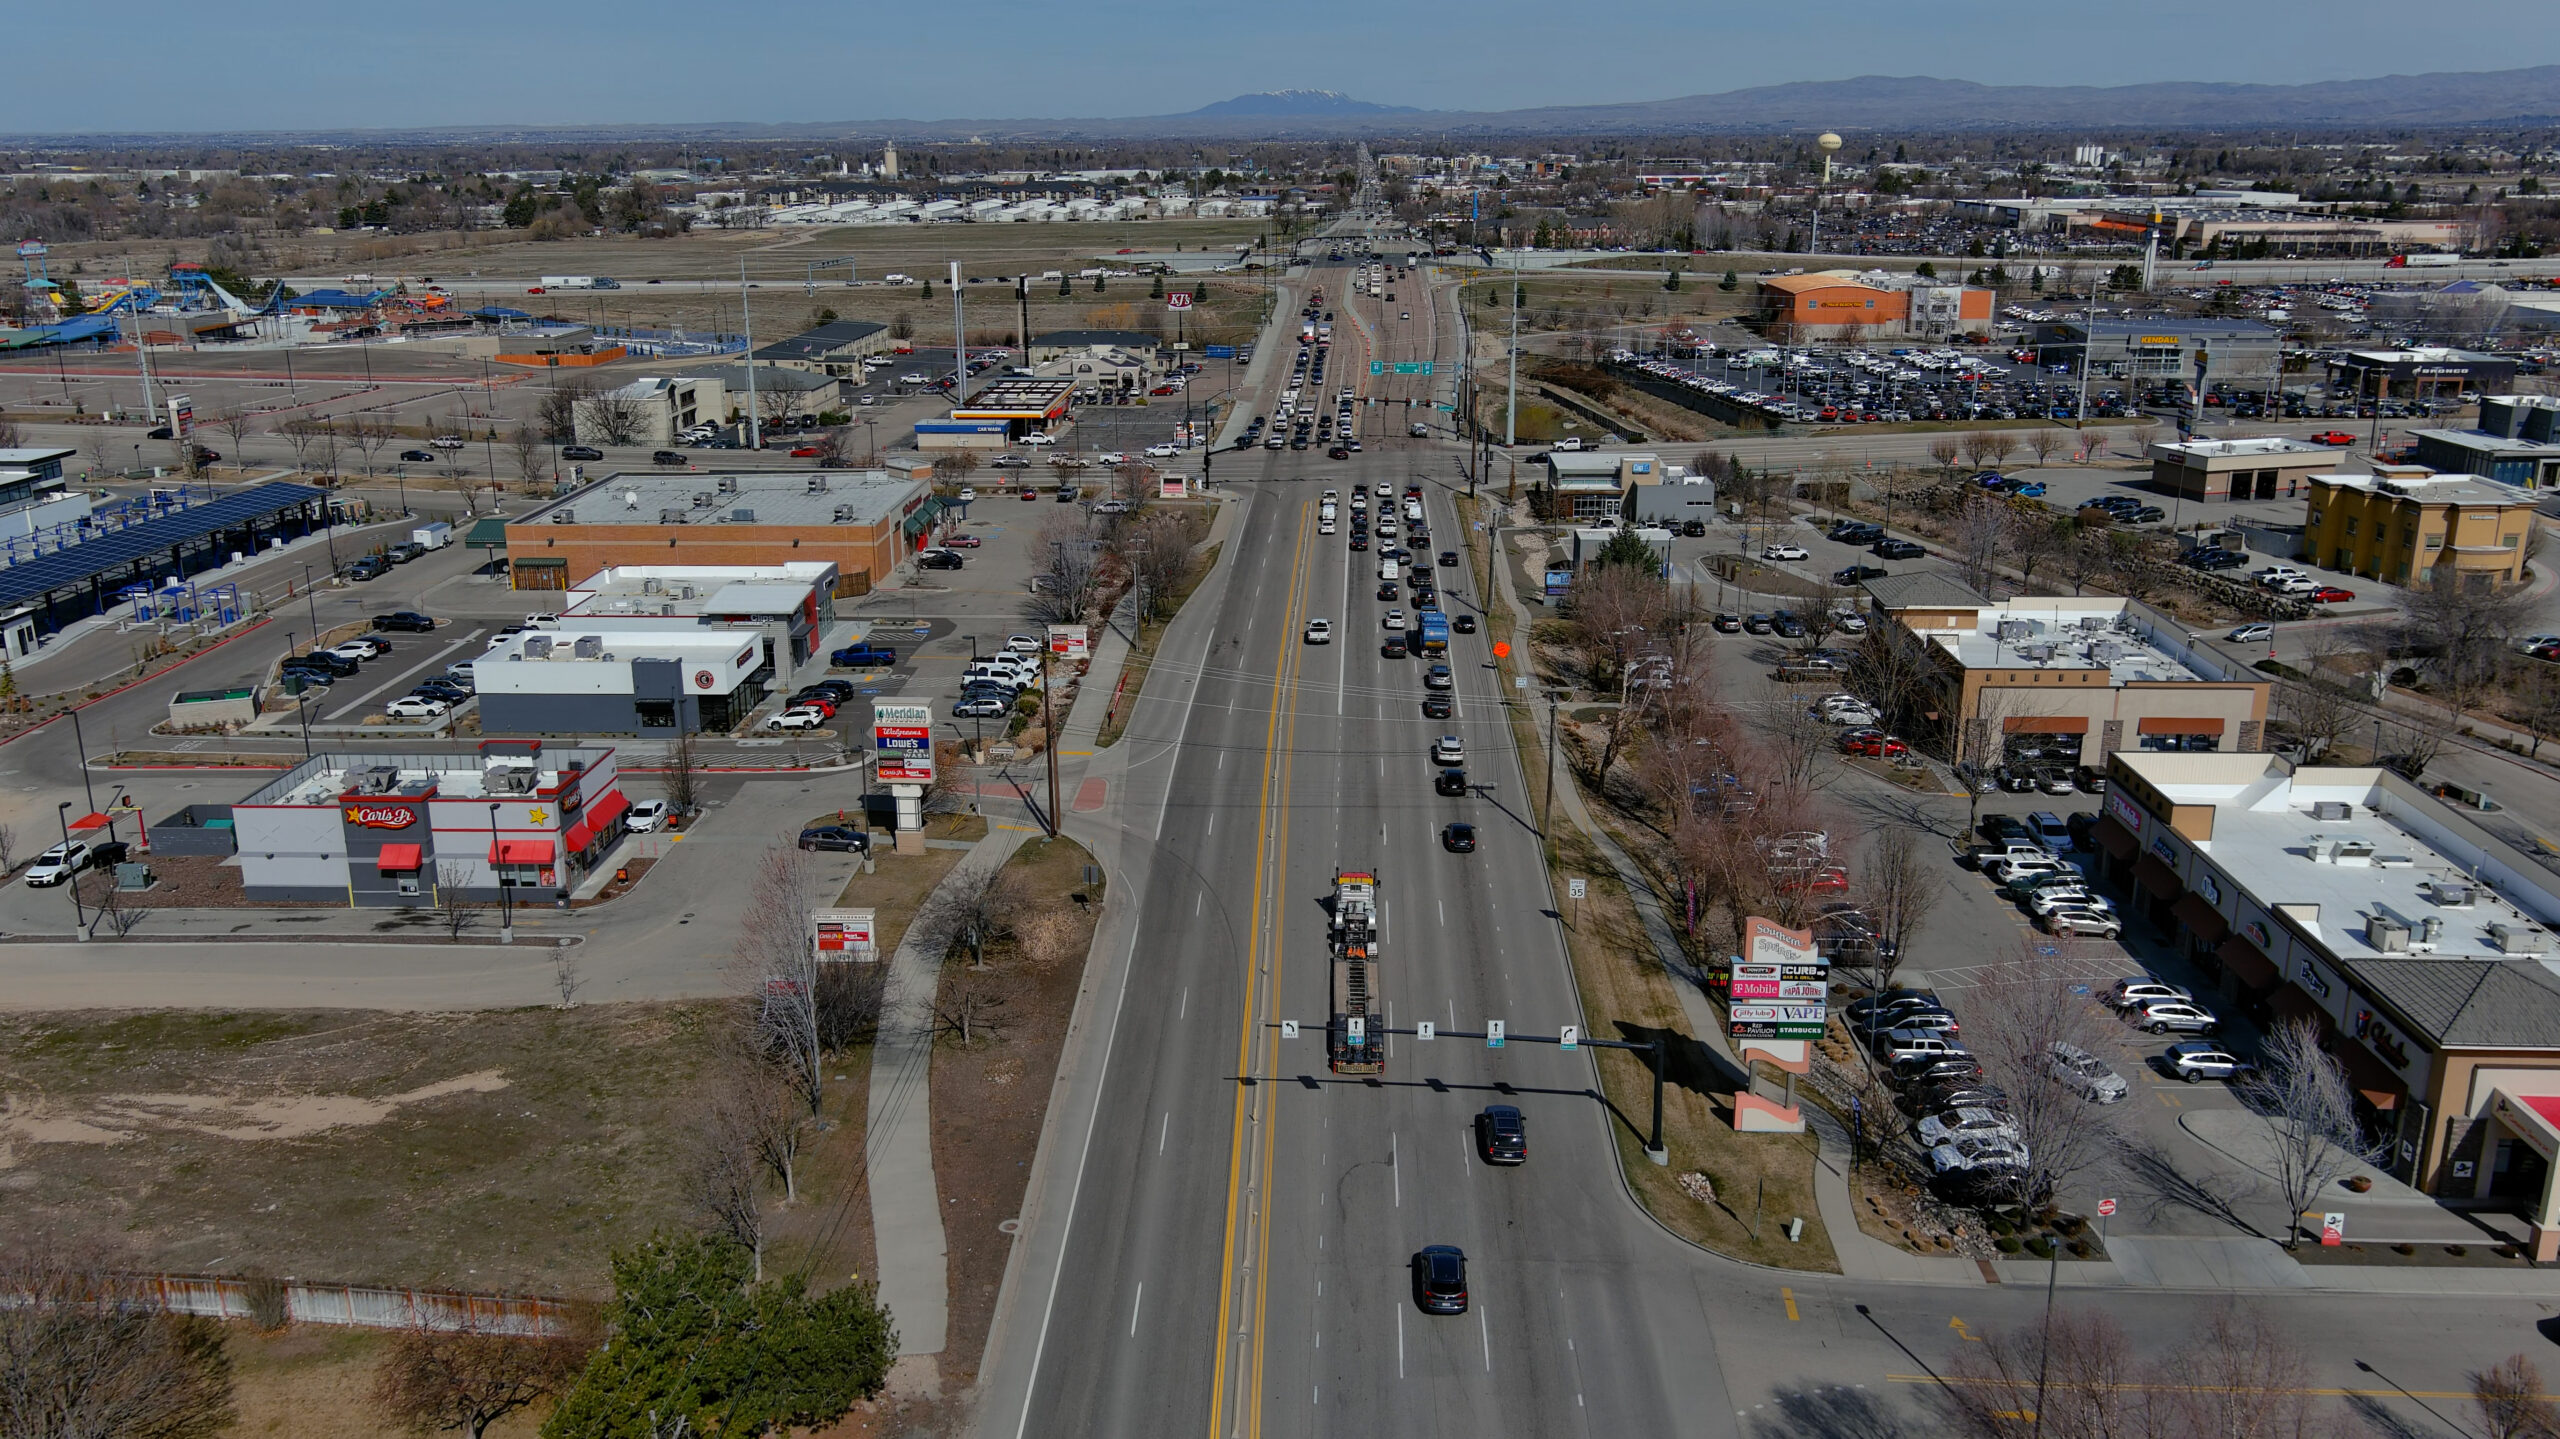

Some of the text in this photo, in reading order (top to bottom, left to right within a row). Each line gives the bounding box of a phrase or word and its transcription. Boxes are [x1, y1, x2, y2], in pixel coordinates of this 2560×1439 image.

[1170, 294, 1190, 306] KJ's
[2141, 336, 2179, 344] KENDALL
[750, 614, 775, 622] Clips
[885, 708, 926, 719] Meridian
[883, 728, 922, 737] Walgreens
[887, 738, 919, 748] LOWE'S
[360, 808, 415, 822] Carl's Jr.
[1756, 924, 1802, 946] Southern
[1759, 939, 1799, 960] Springs
[1786, 966, 1817, 975] CURB
[1744, 983, 1778, 994] Mobile
[1784, 985, 1822, 996] PAPA JOHNS
[1739, 1008, 1771, 1017] jiffy lube
[1784, 1007, 1823, 1020] VAPE
